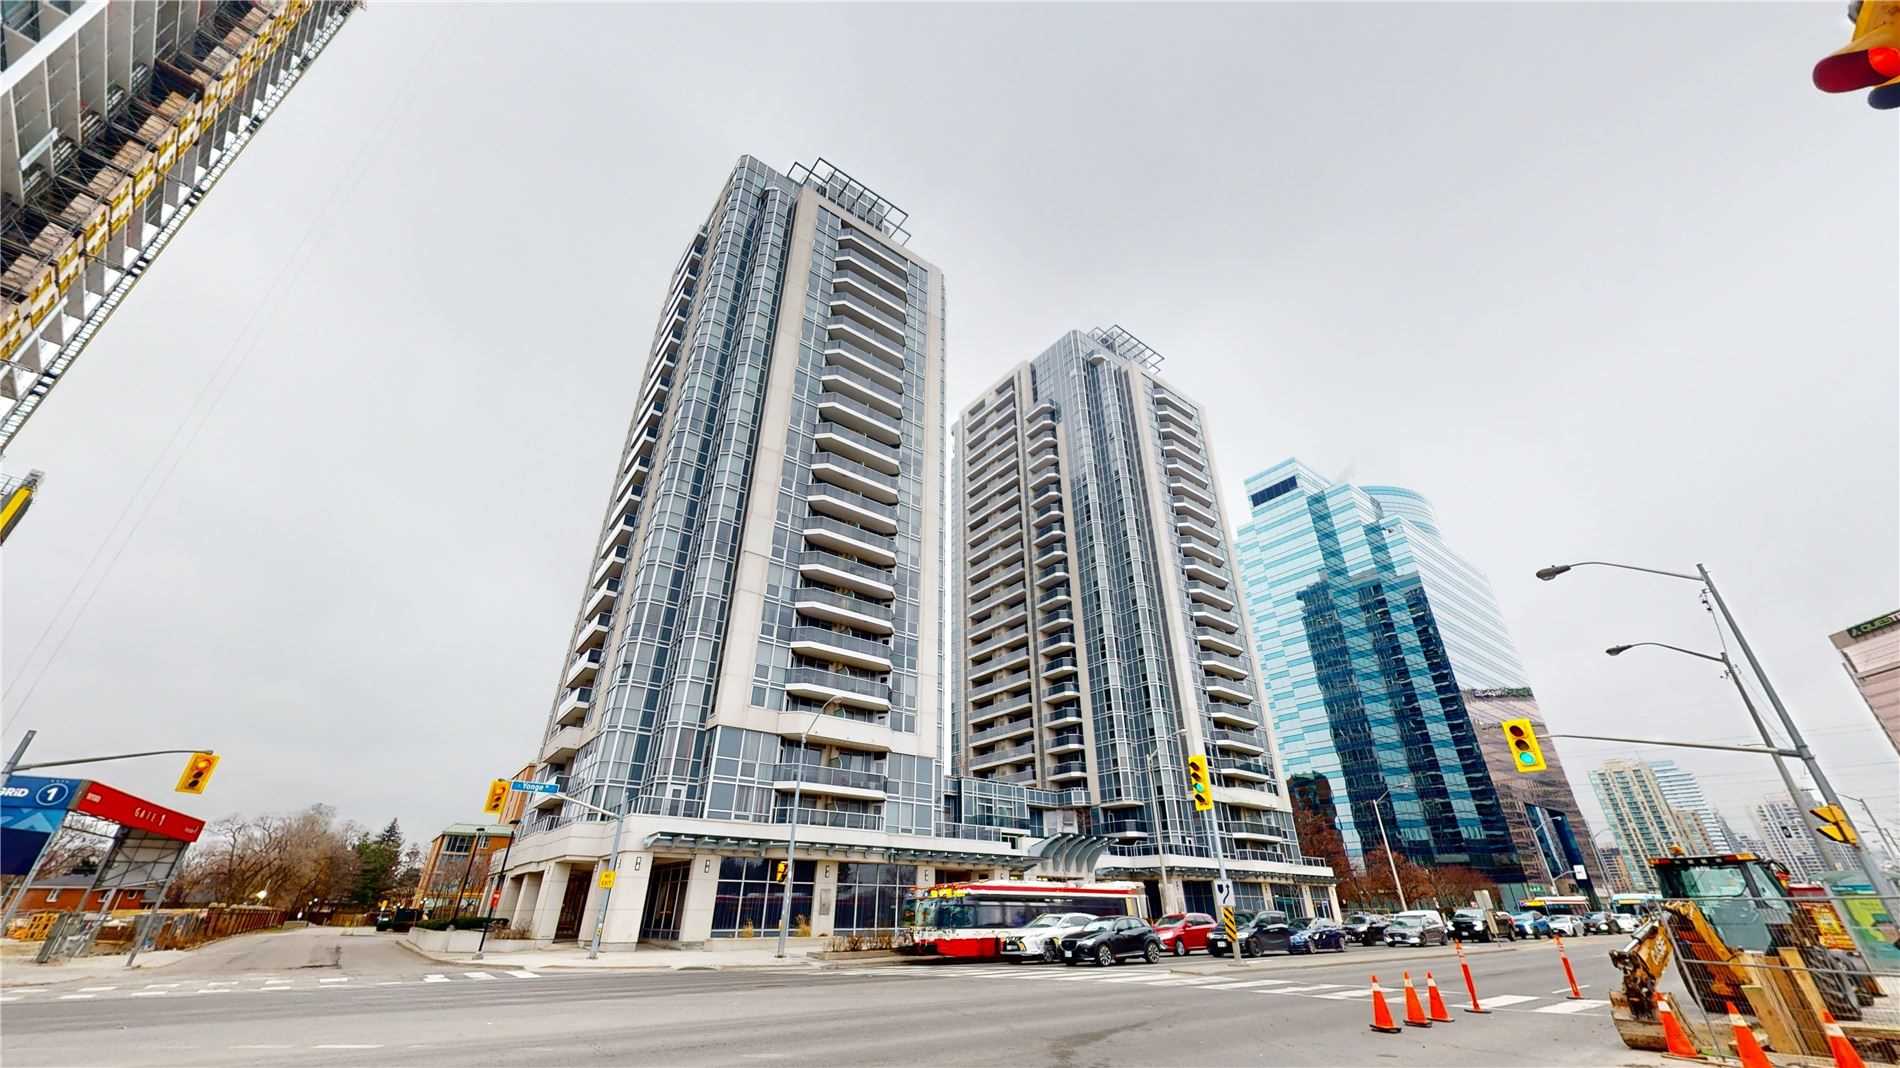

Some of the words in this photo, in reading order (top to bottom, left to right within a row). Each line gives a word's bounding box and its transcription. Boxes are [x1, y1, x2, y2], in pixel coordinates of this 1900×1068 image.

[47, 787, 59, 802] 1
[523, 783, 544, 792] Yonge
[135, 807, 157, 823] GATE
[159, 813, 166, 827] 1
